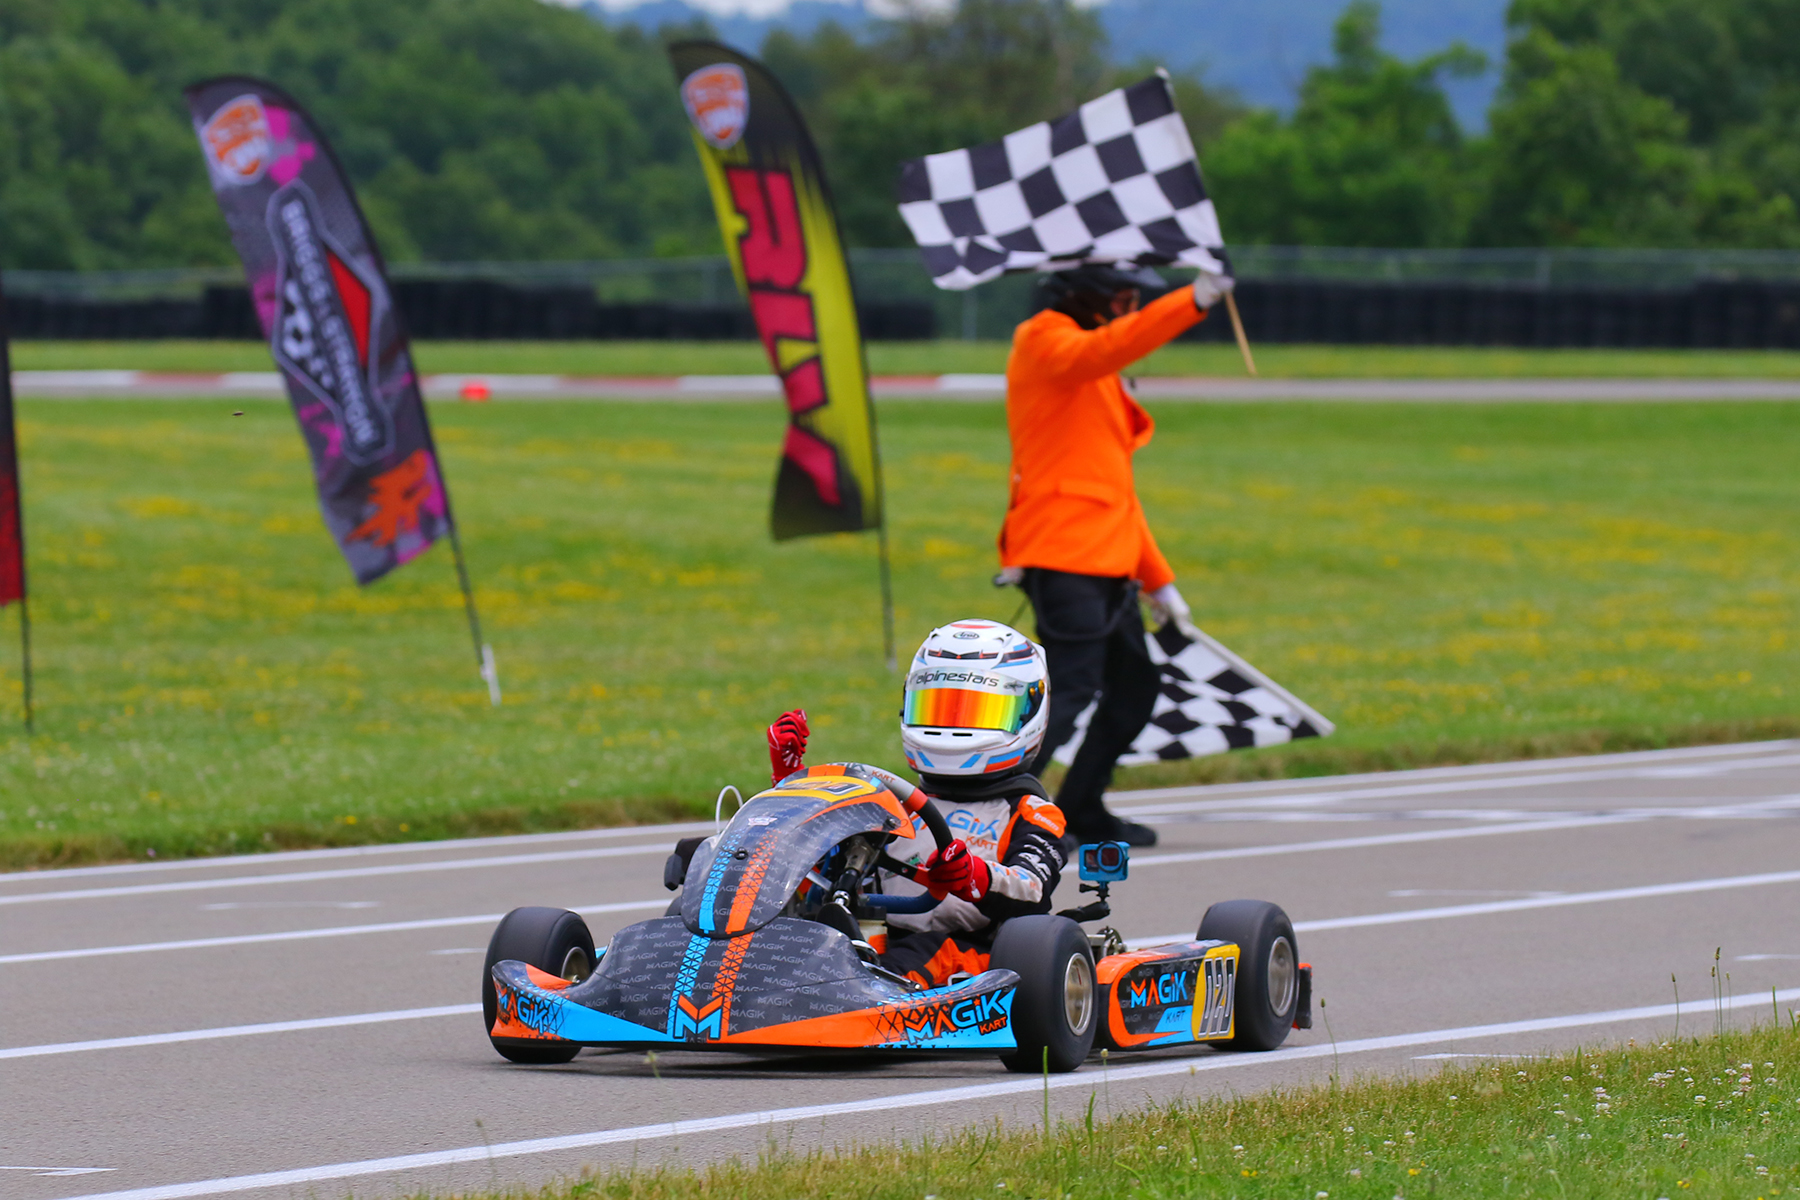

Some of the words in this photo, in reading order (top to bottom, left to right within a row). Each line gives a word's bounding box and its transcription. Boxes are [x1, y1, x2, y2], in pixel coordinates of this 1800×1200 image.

[916, 670, 1000, 687] alpinestars
[964, 835, 998, 851] KART
[979, 1016, 1007, 1035] KART
